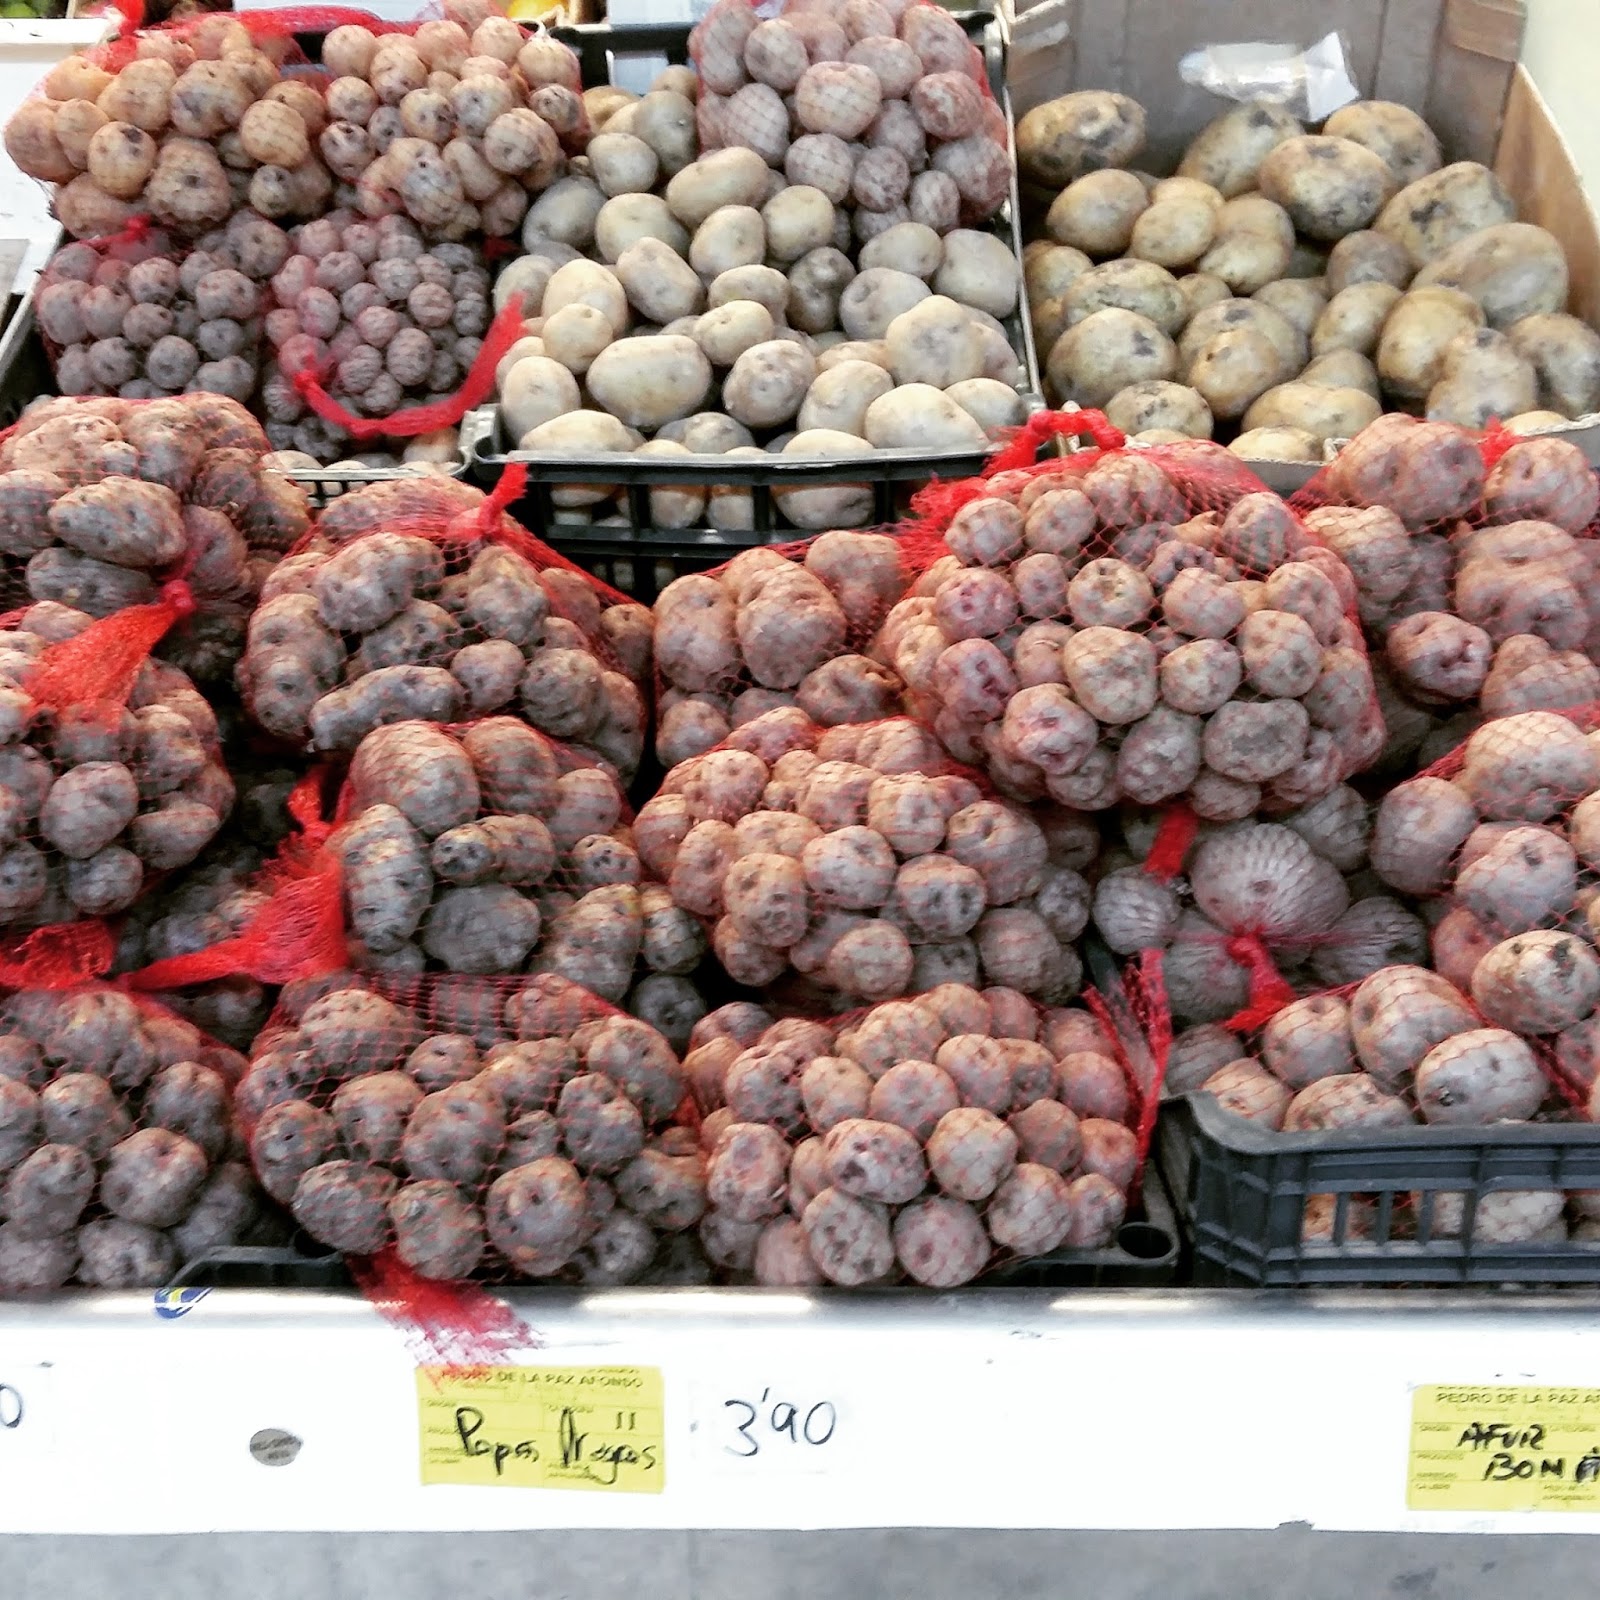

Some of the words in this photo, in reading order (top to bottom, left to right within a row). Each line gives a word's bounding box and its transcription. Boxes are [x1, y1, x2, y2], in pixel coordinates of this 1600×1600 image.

[499, 1371, 516, 1383] DE
[545, 1373, 575, 1386] PAZ
[1436, 1392, 1492, 1404] PEDRO
[1497, 1392, 1519, 1404] DE
[1523, 1392, 1543, 1405] LA
[1549, 1392, 1580, 1404] PAZ
